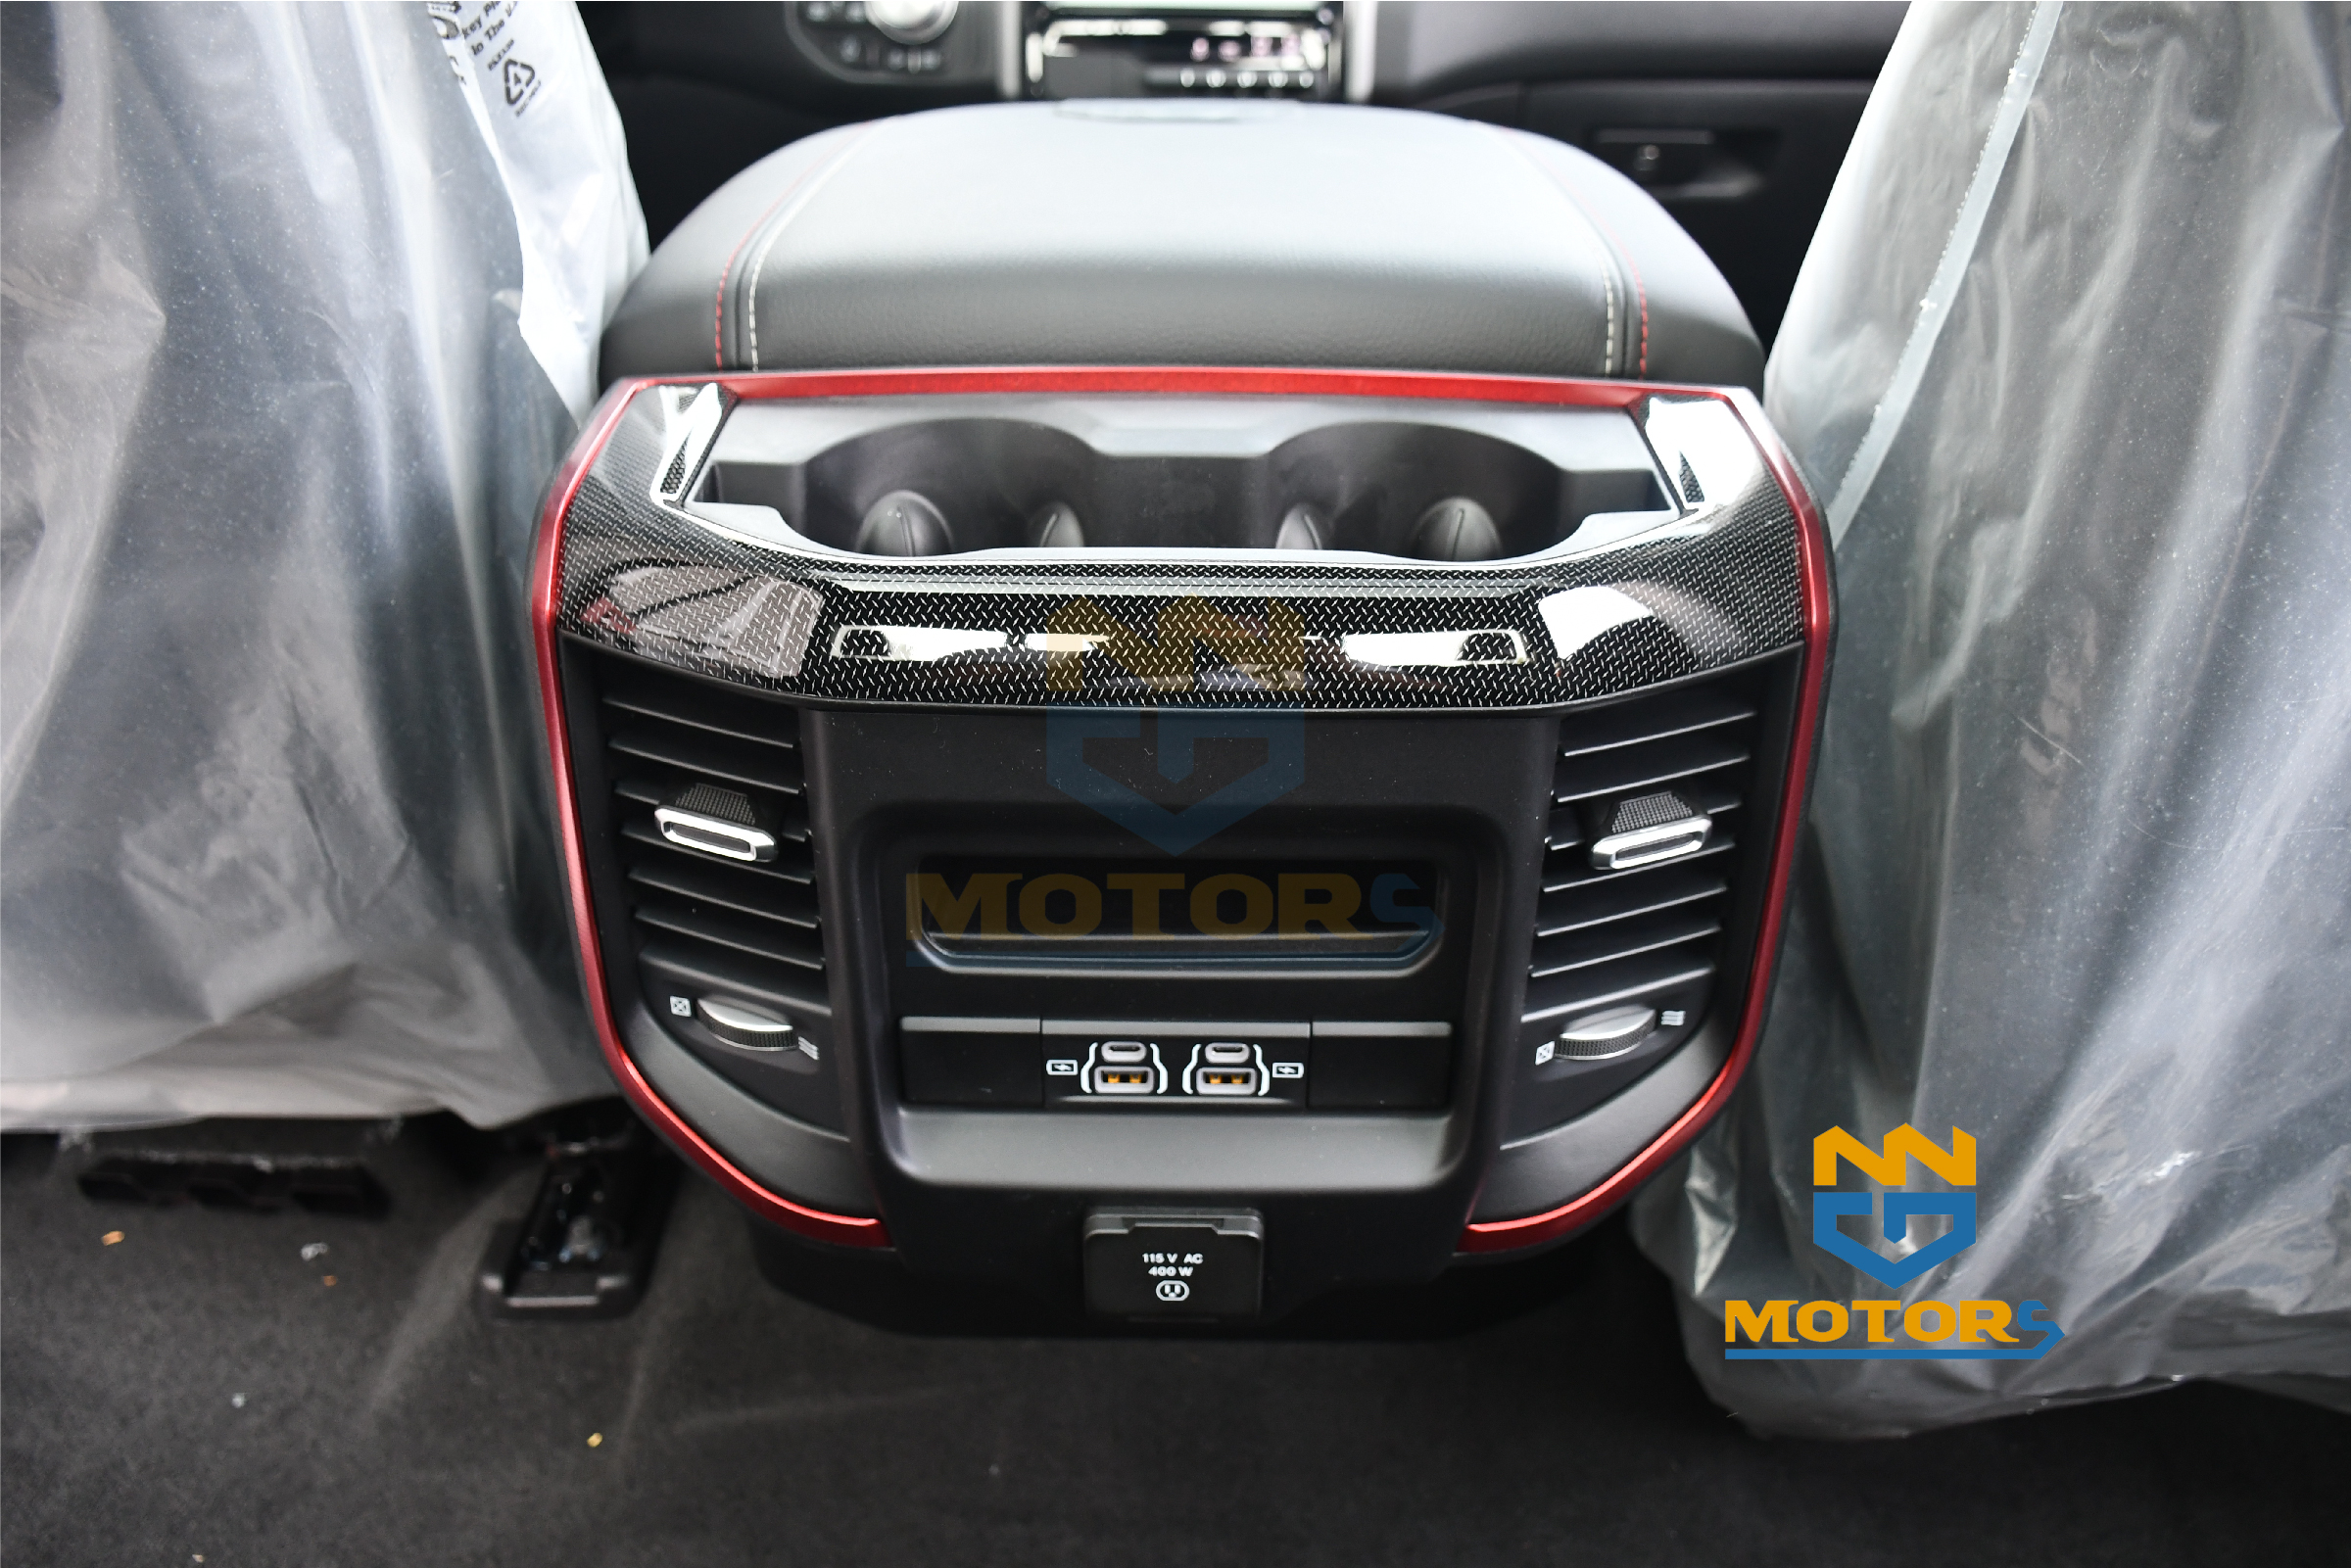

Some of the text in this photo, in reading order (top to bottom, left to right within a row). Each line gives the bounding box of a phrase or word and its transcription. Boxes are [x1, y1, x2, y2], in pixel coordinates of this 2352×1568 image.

[1142, 1253, 1204, 1264] 115 V AC
[1148, 1265, 1194, 1277] 400 W
